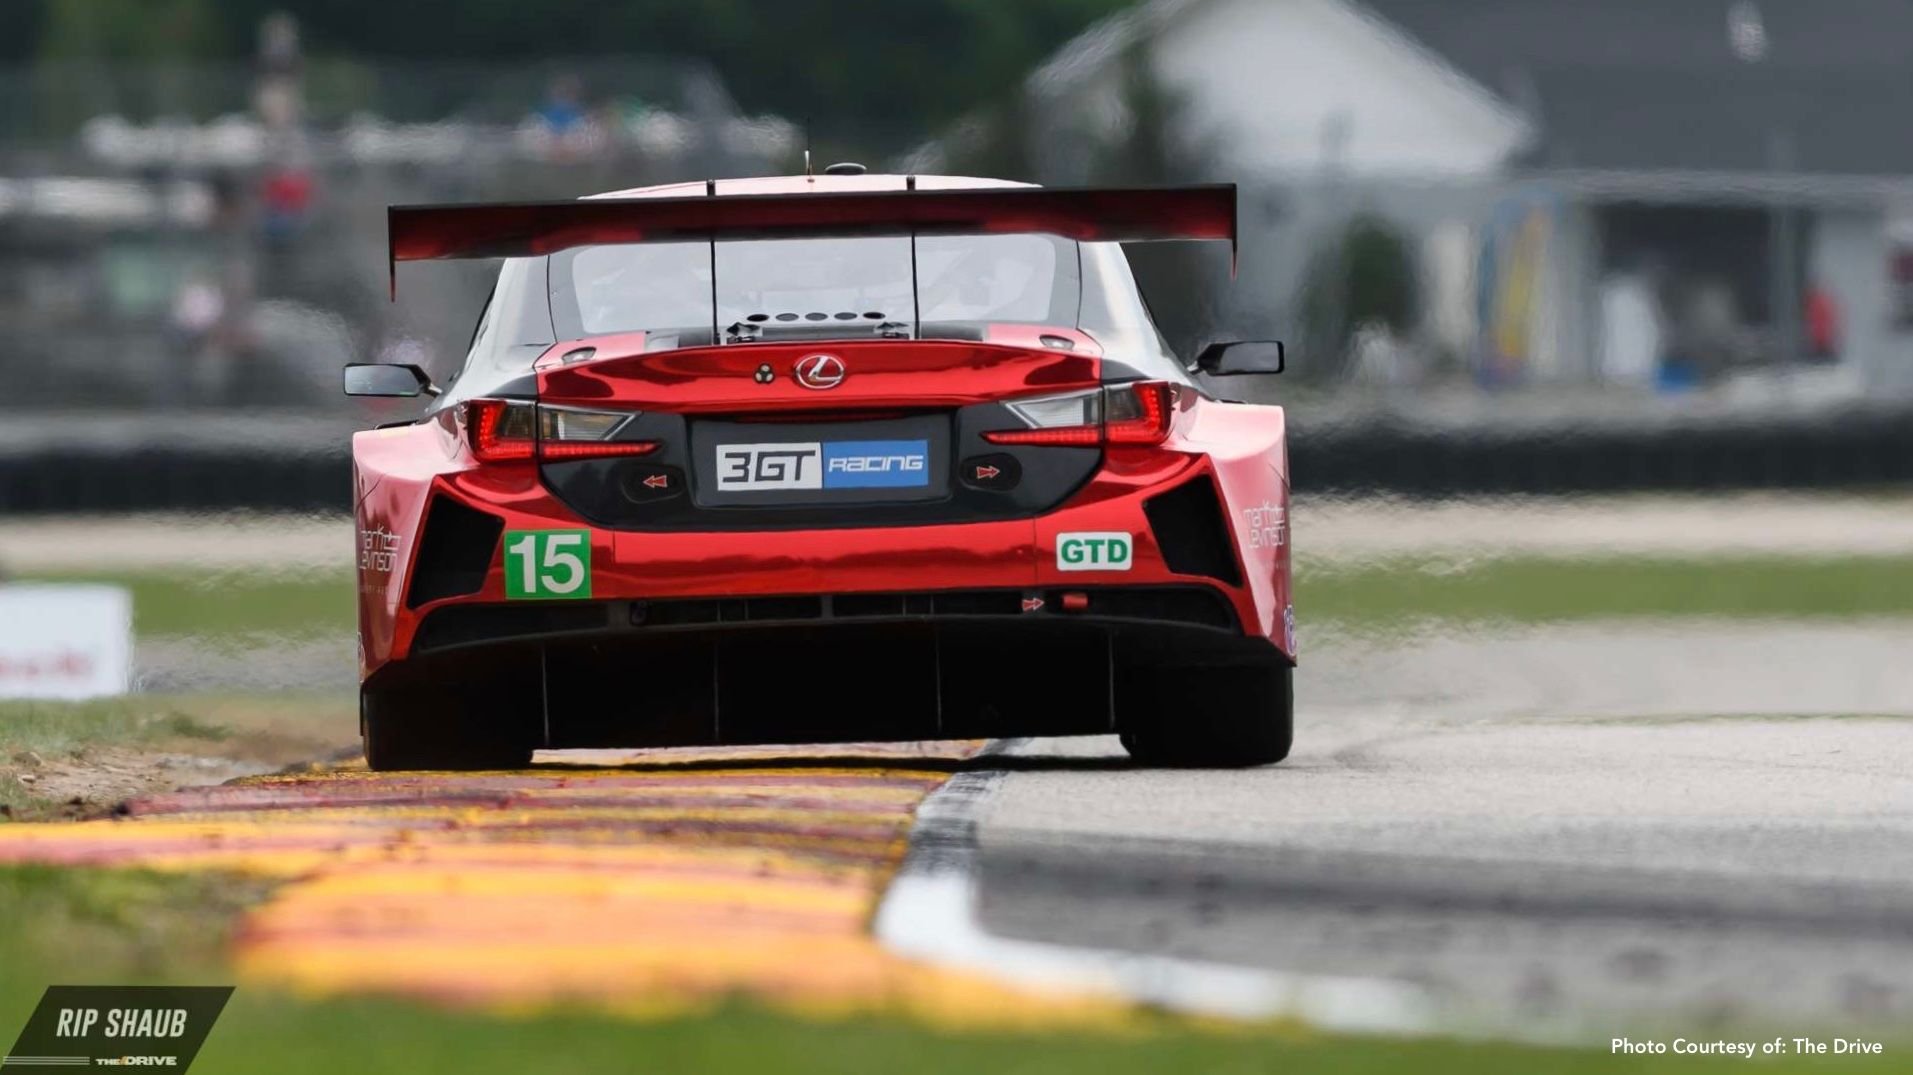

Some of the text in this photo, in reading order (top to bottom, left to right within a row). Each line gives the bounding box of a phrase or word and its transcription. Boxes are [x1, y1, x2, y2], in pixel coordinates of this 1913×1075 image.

[722, 450, 816, 483] 3GT
[509, 534, 585, 594] 15
[1060, 538, 1129, 564] GTD
